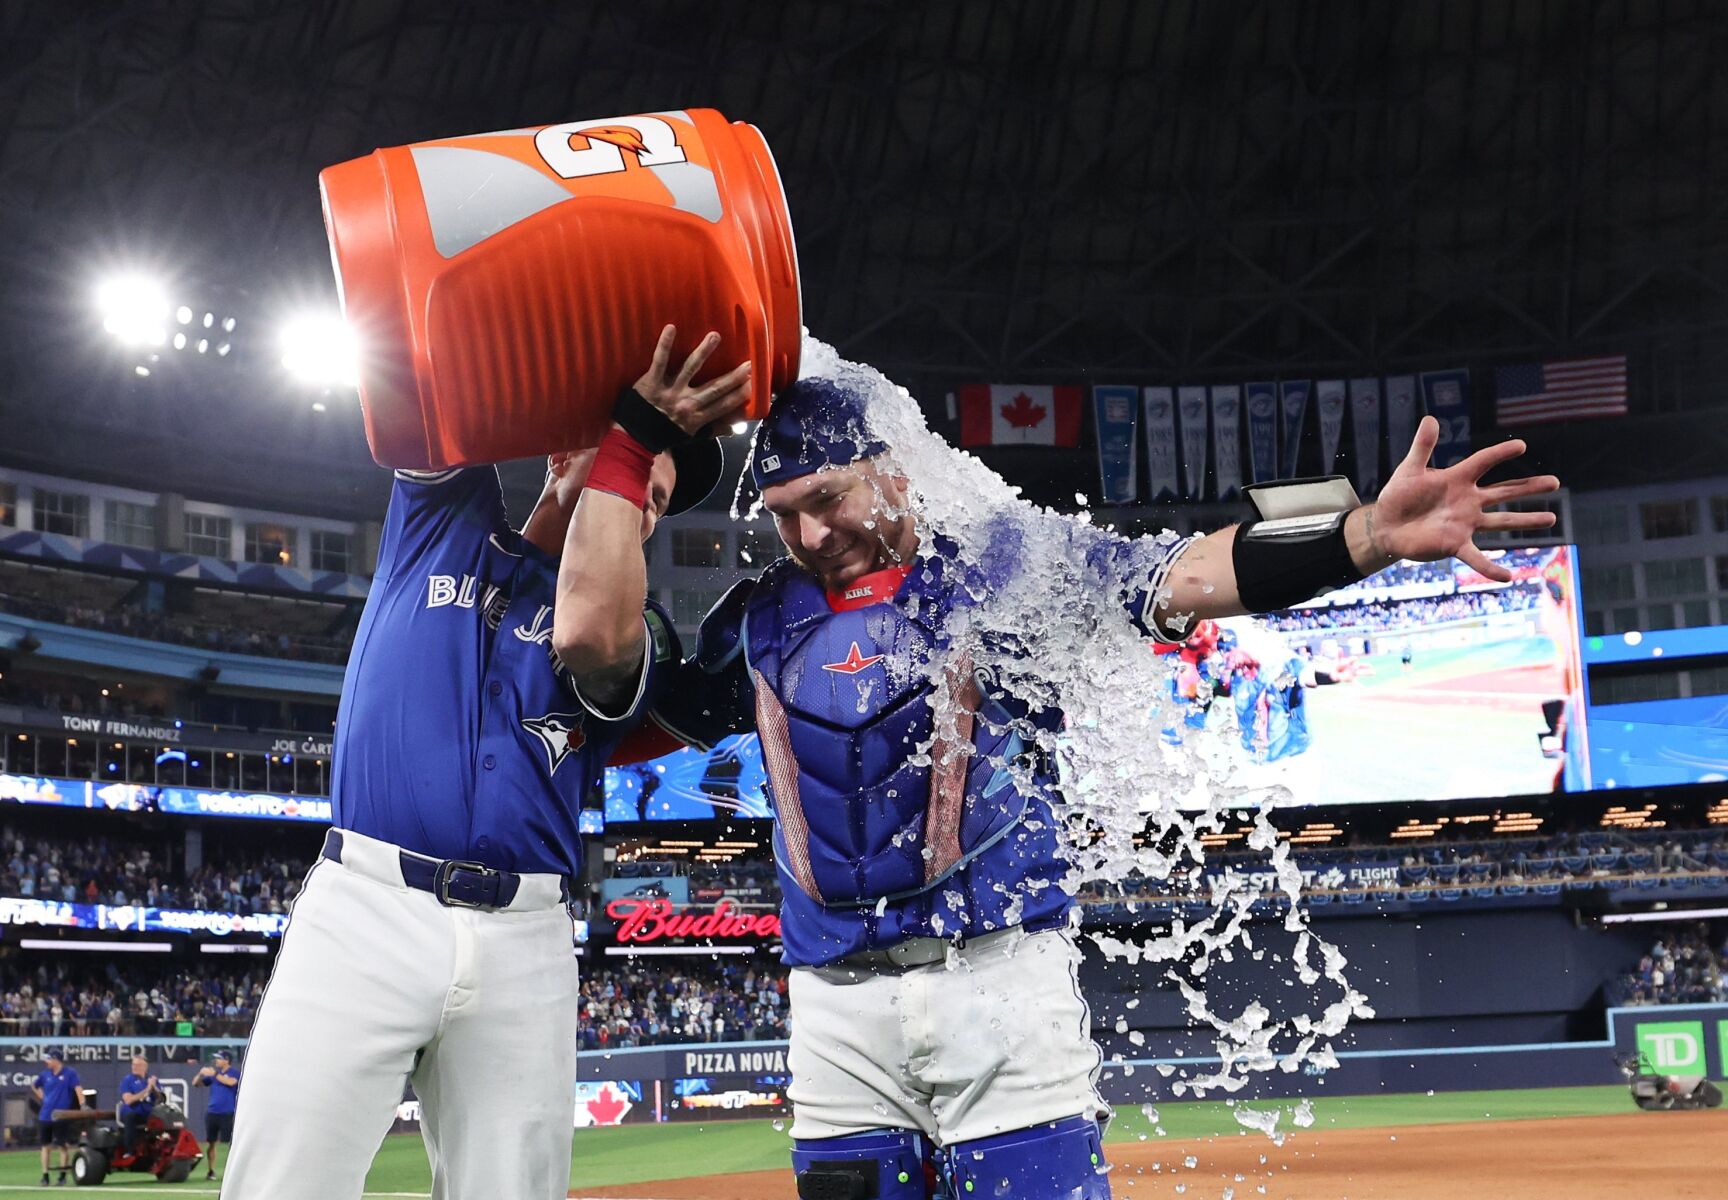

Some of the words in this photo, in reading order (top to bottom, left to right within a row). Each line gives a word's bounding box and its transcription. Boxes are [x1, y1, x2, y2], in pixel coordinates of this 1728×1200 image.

[534, 115, 689, 180] G
[845, 586, 874, 600] KIRK
[62, 716, 101, 732] TONY
[106, 721, 181, 742] FERNANDEZ
[271, 739, 297, 753] JOE
[301, 742, 333, 755] CART
[300, 800, 332, 818] BLU
[1350, 867, 1399, 880] FLIGHT
[606, 898, 782, 942] Budwe
[1644, 1032, 1698, 1067] TD
[685, 1053, 736, 1075] PIZZA
[740, 1051, 786, 1073] NOVA
